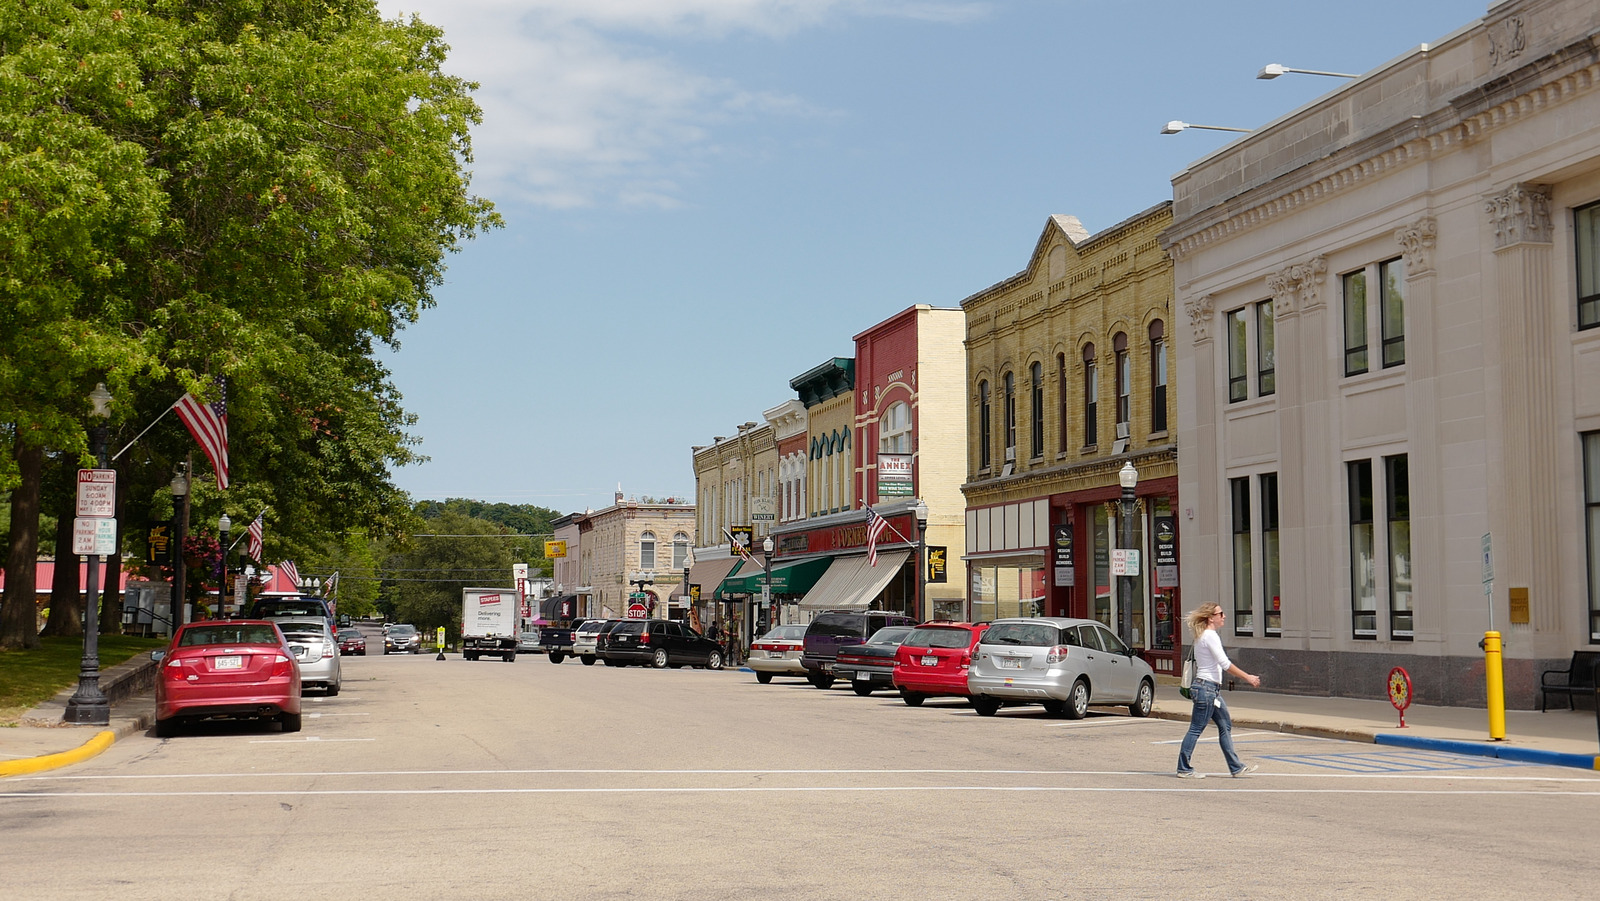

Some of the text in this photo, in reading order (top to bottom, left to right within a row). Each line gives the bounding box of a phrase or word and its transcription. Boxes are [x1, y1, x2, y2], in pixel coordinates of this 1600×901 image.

[879, 461, 912, 470] ANNEX
[80, 472, 93, 481] NO
[838, 525, 867, 548] CORNER
[480, 595, 501, 603] STAPLES
[628, 609, 646, 618] STOP
